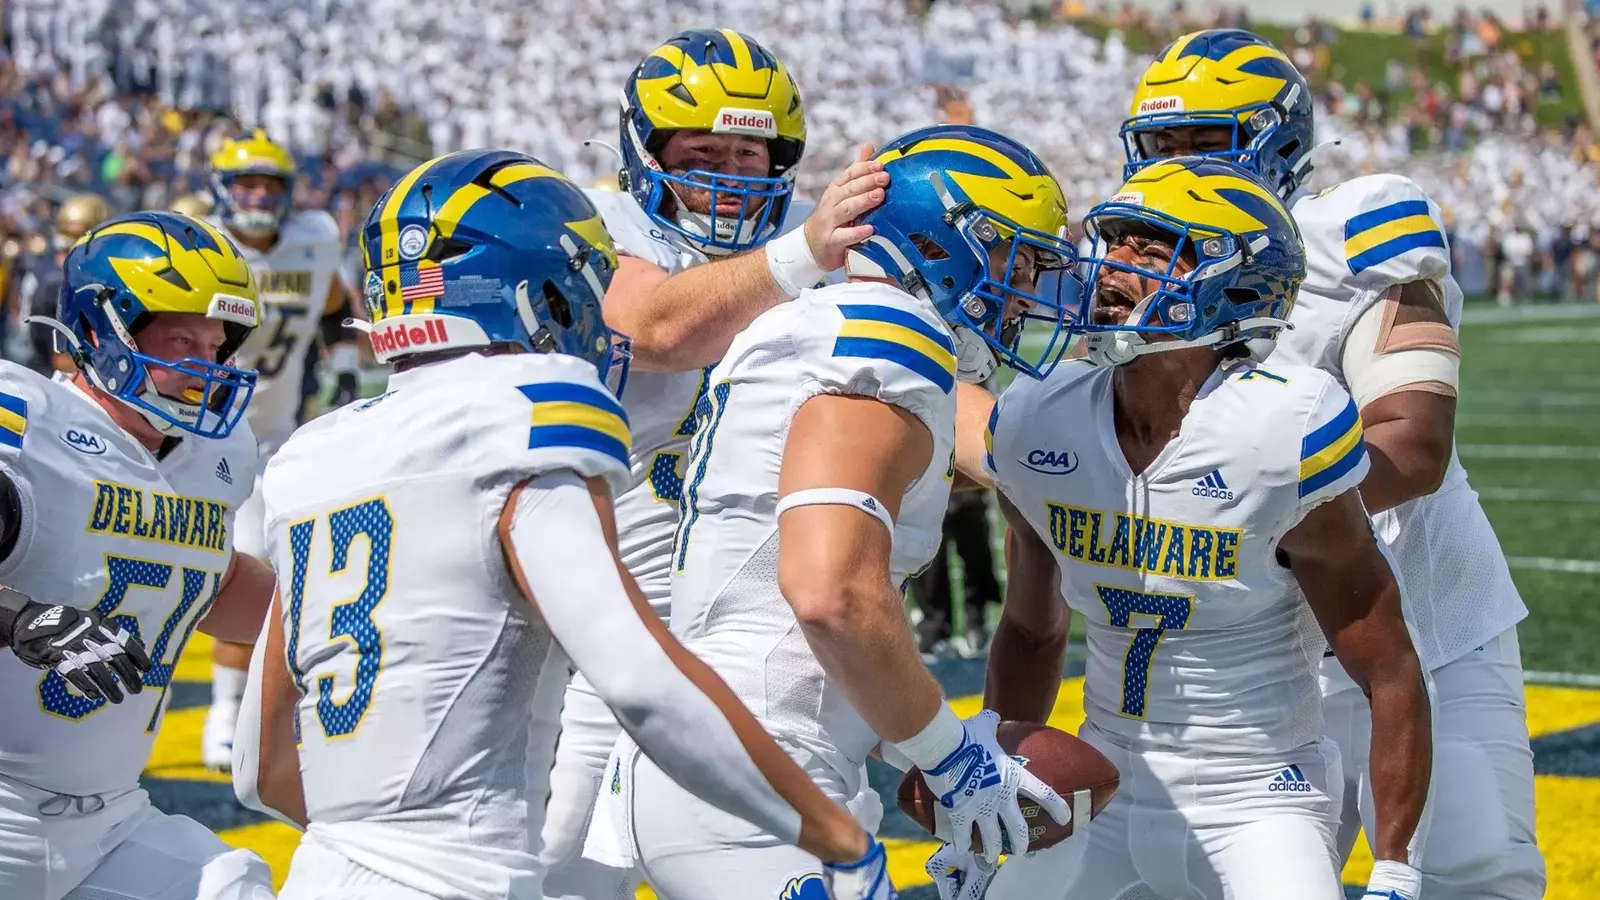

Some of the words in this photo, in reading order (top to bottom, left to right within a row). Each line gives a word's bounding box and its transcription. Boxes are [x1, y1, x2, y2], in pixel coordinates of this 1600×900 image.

[1141, 99, 1177, 112] Riddell
[722, 113, 773, 129] Riddell
[217, 300, 255, 318] Riddell
[370, 319, 448, 354] Riddell
[67, 430, 100, 449] CAA
[1028, 449, 1070, 468] CAA
[1192, 486, 1234, 501] adidas
[1045, 501, 1244, 581] DELAWARE
[285, 495, 395, 742] 13
[1092, 581, 1197, 721] 7
[1268, 780, 1311, 792] adidas
